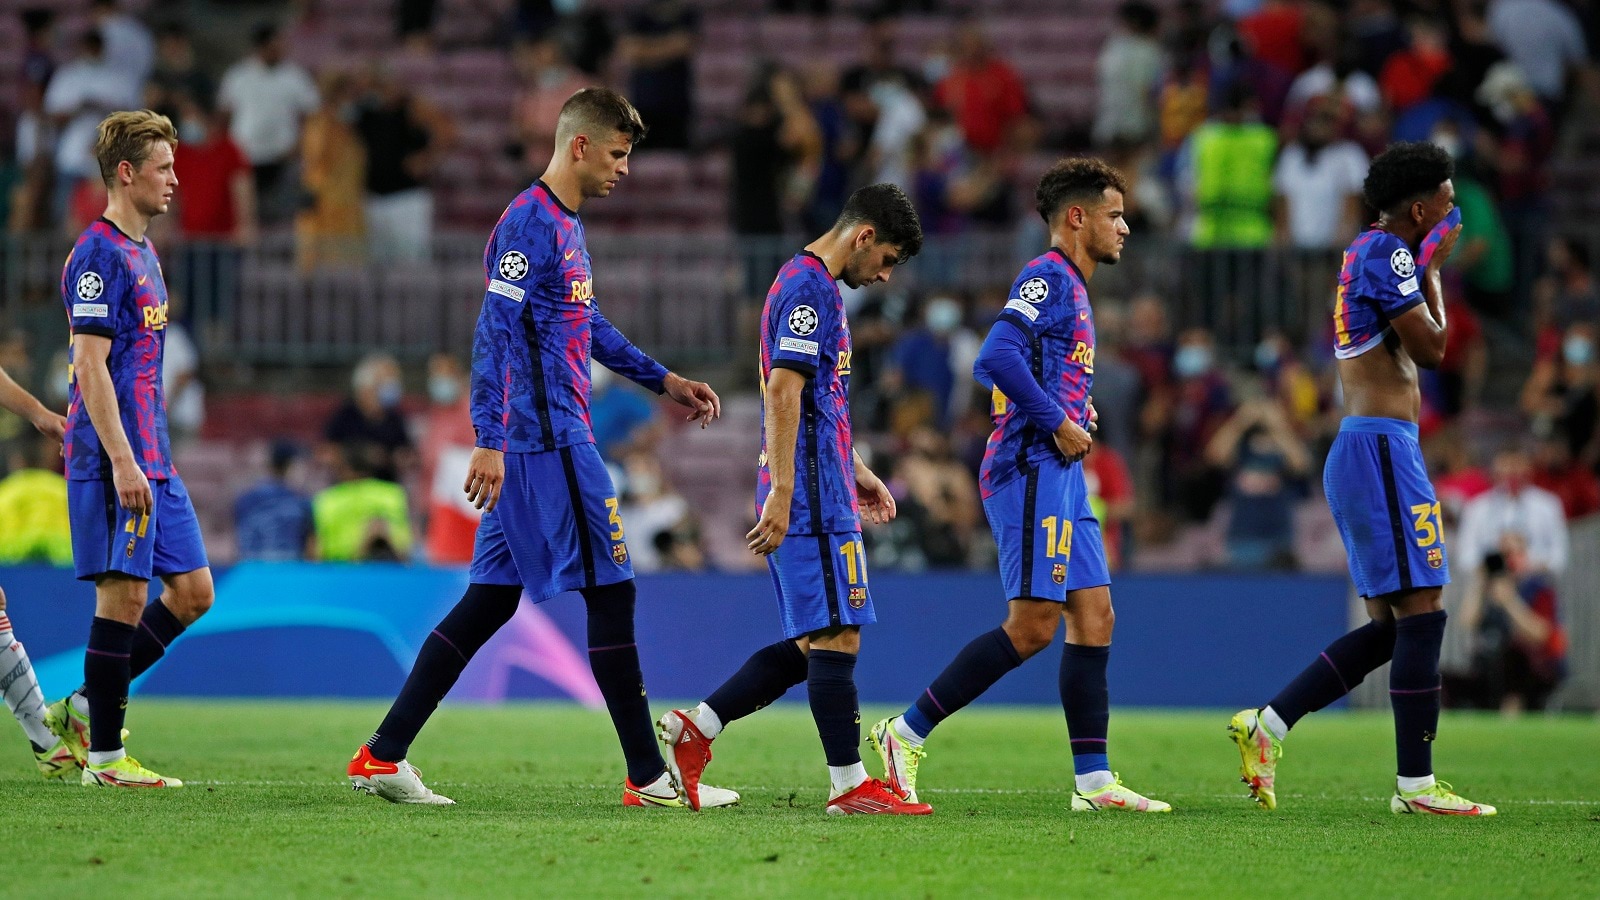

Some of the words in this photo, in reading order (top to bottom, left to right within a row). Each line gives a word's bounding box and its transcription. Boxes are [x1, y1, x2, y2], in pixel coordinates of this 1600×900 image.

[605, 497, 624, 540] 3
[1042, 516, 1073, 562] 14
[1411, 501, 1445, 547] 31
[840, 541, 867, 584] 11
